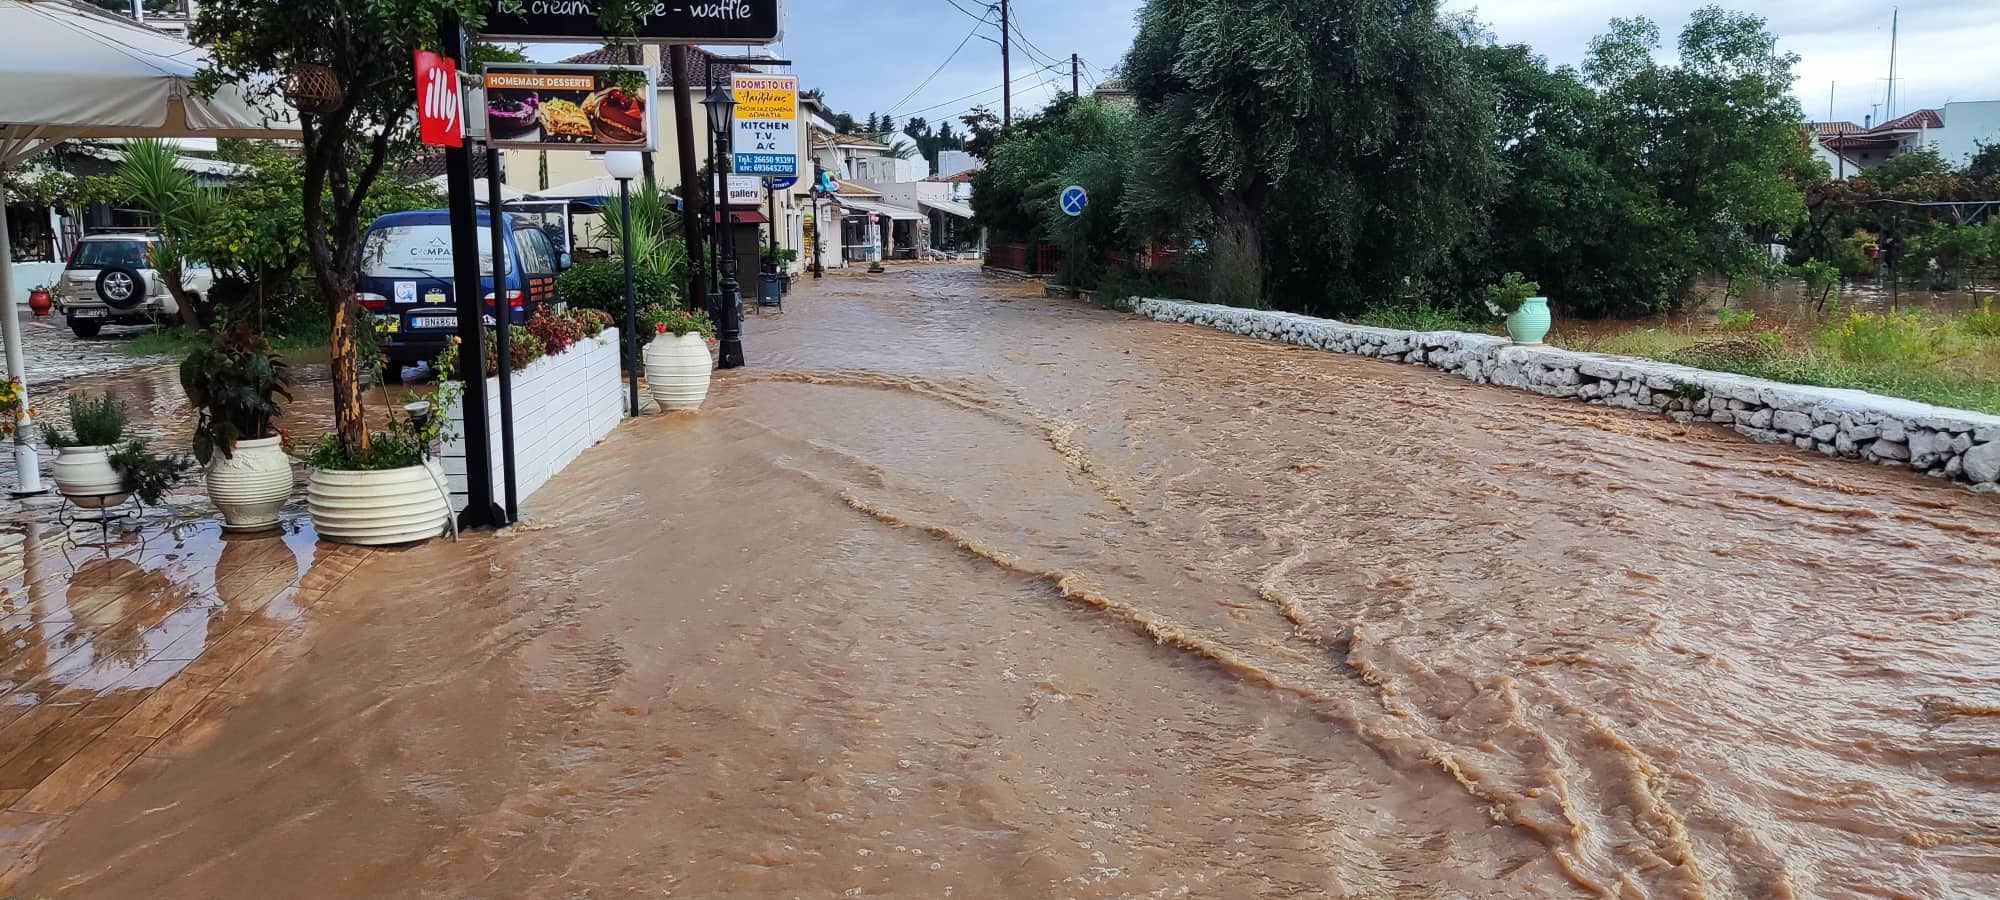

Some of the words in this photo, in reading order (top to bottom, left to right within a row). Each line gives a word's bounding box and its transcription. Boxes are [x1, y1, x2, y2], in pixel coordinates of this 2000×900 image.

[532, 0, 590, 16] cream
[690, 0, 752, 20] waffle
[490, 76, 545, 87] HOMEMADE
[546, 77, 591, 88] DESSERTS
[735, 80, 766, 89] ROOMS
[766, 80, 778, 89] TO
[780, 80, 794, 89] LET
[425, 67, 457, 133] illy
[741, 121, 789, 130] KITCHEN
[755, 132, 776, 140] T.V.
[756, 142, 776, 150] A/C
[753, 156, 774, 164] 26650
[774, 156, 794, 165] 93391
[730, 189, 758, 199] gallery
